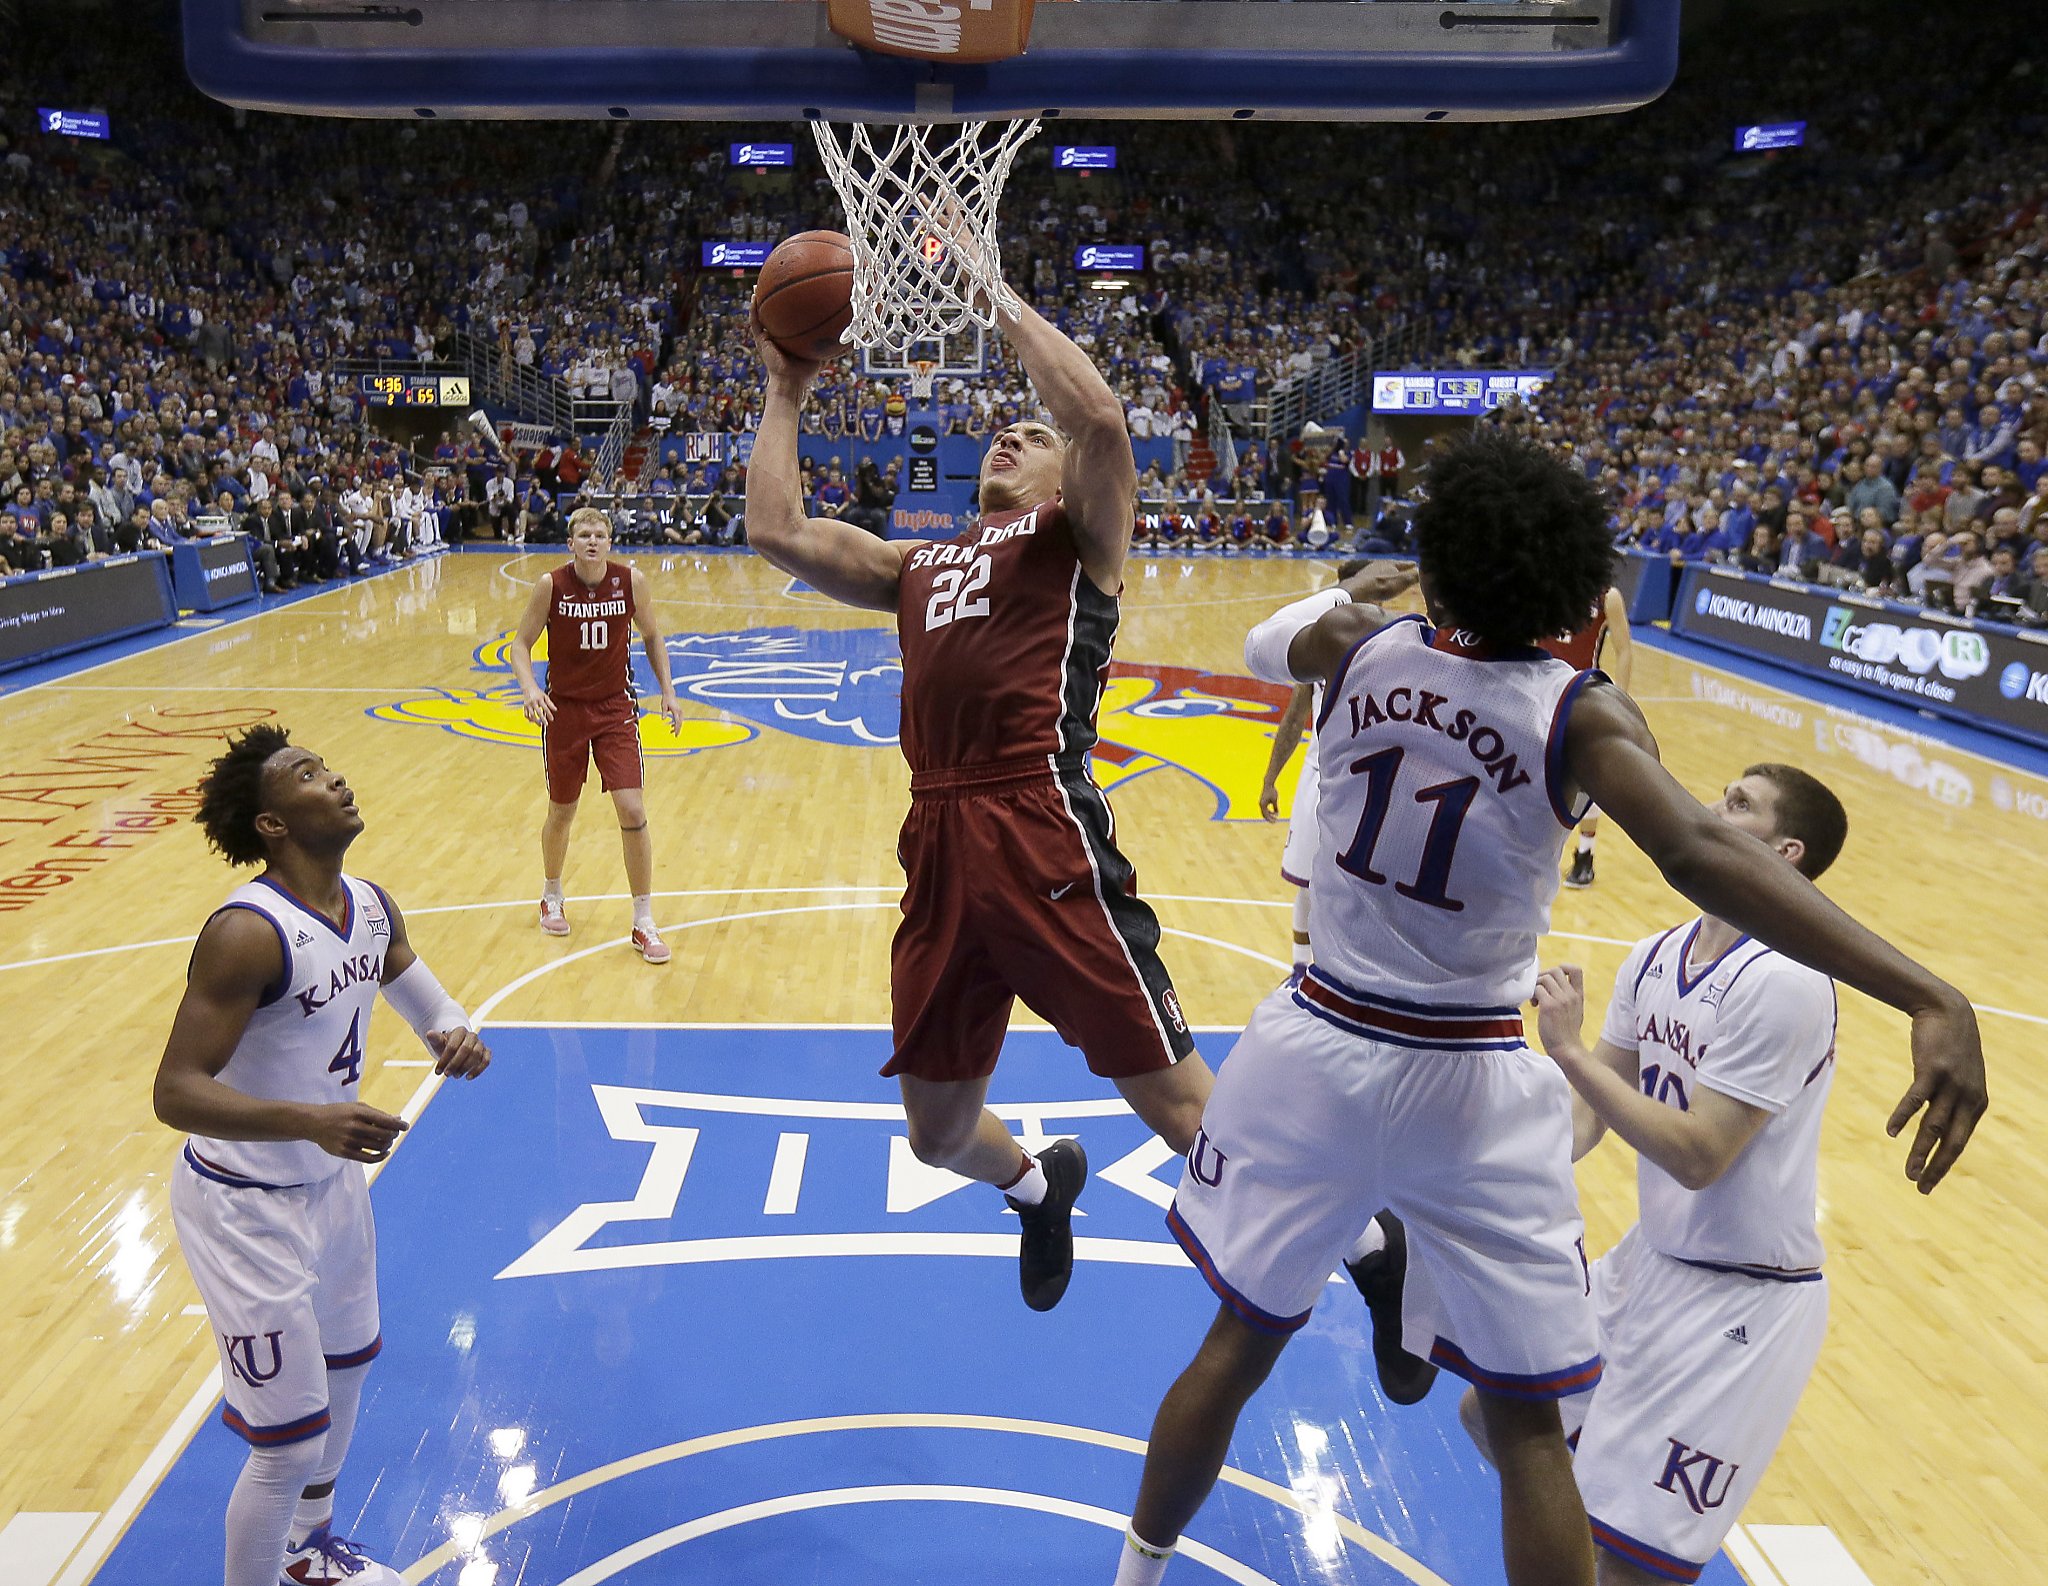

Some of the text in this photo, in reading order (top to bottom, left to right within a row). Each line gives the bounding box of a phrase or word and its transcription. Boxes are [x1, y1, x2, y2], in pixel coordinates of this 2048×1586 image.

[869, 0, 985, 53] arm
[374, 377, 402, 392] 4:36
[417, 388, 435, 404] 65
[909, 511, 1038, 572] STANORD
[558, 600, 627, 618] STANFORD
[925, 553, 992, 632] 22
[1708, 593, 1812, 641] KONICA MINOLTA
[580, 620, 608, 650] 10
[1449, 628, 1482, 648] KU
[1828, 655, 1956, 703] so easy to flip open & close
[1347, 686, 1532, 795] JACKSON
[1335, 745, 1481, 913] 11
[327, 1006, 362, 1087] 4
[1635, 1012, 1710, 1072] ANSA
[222, 1329, 284, 1388] KU
[1654, 1437, 1740, 1515] KU
